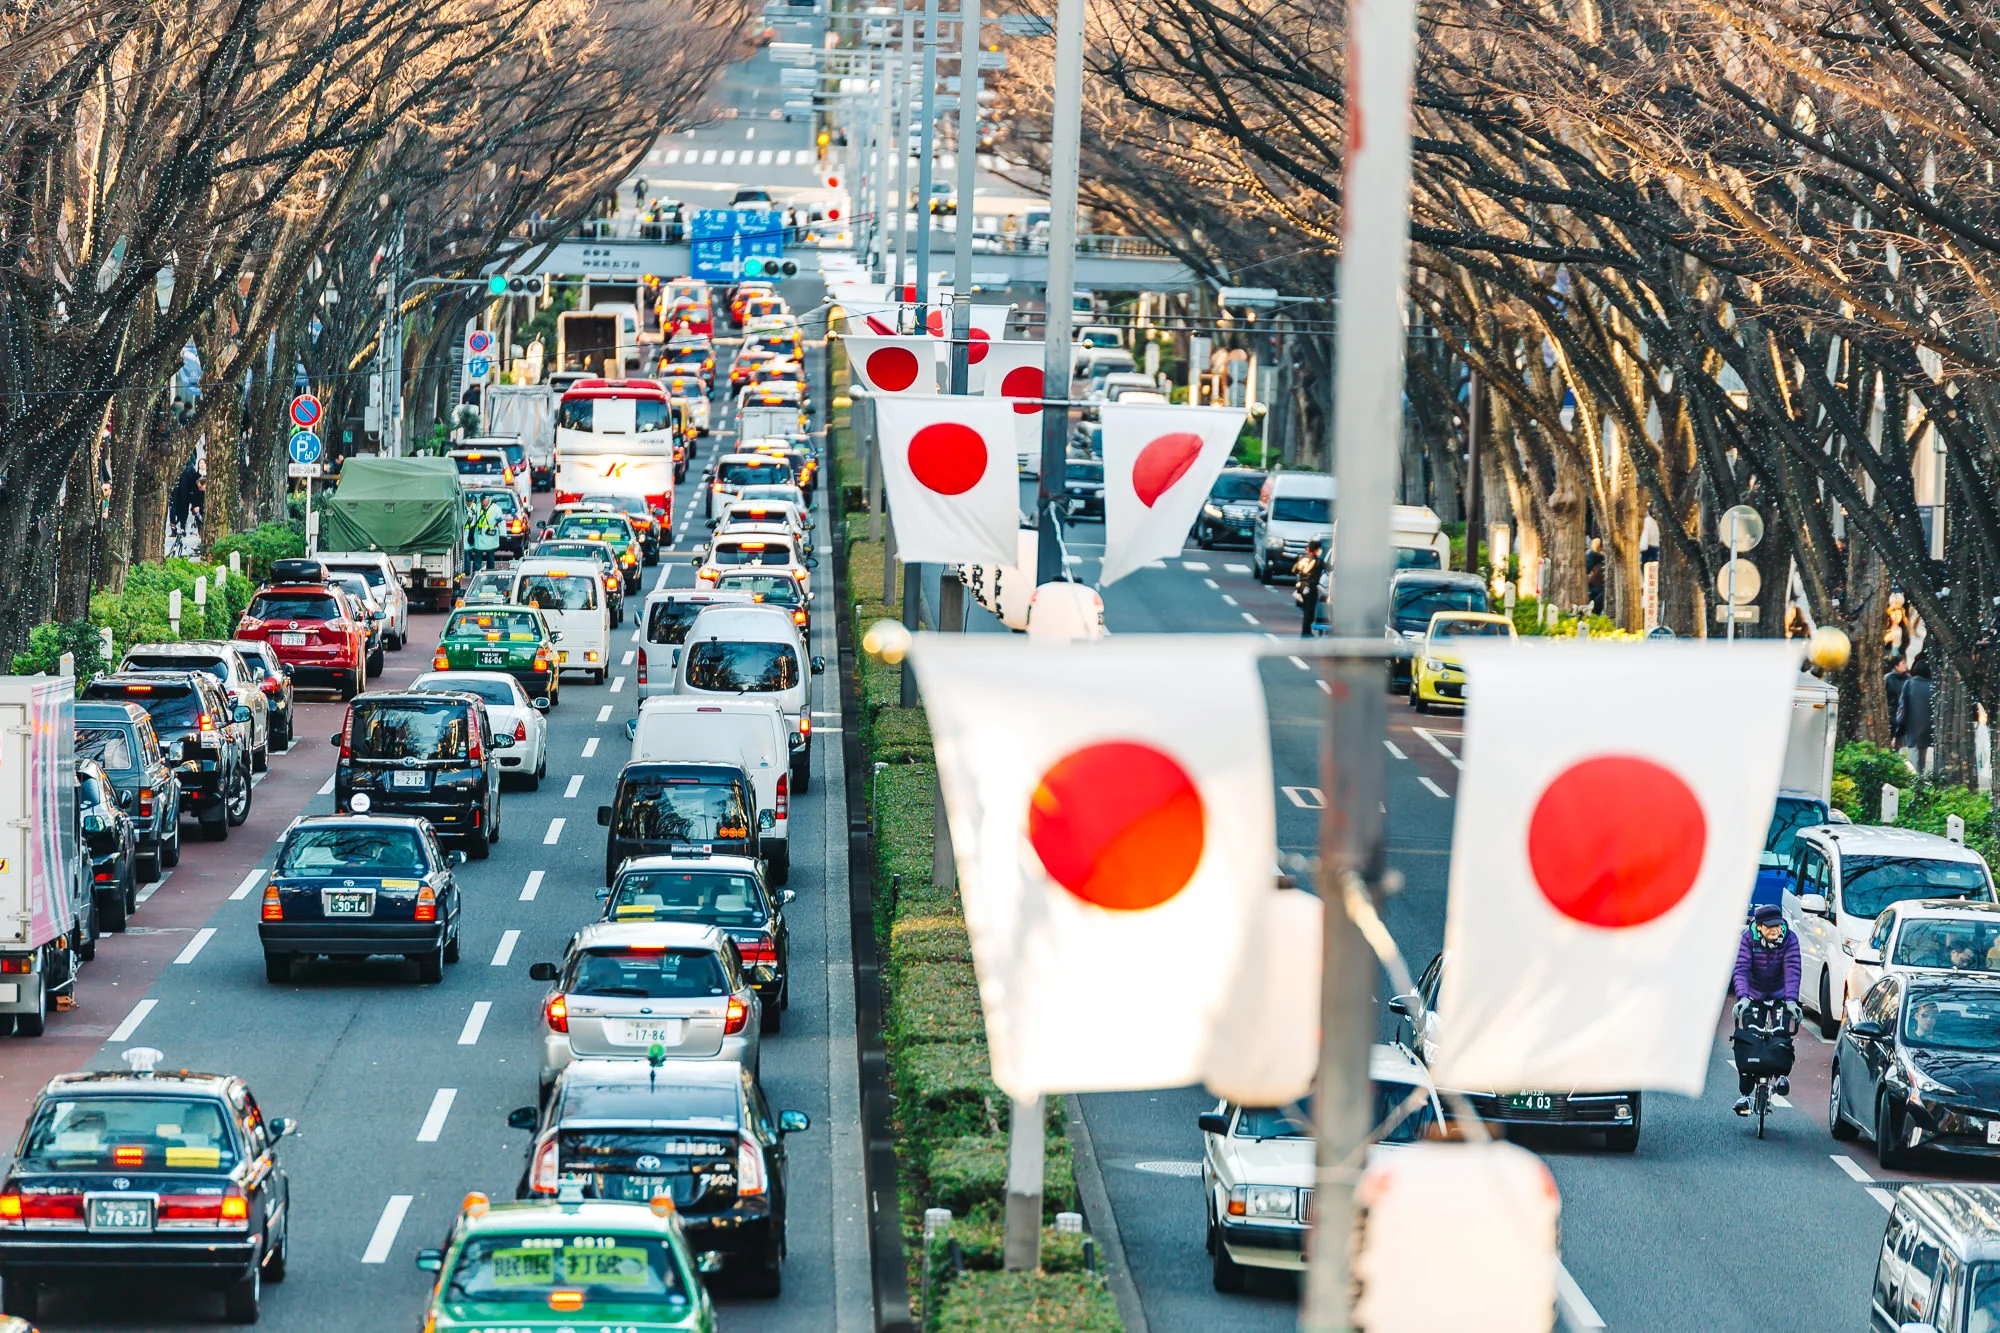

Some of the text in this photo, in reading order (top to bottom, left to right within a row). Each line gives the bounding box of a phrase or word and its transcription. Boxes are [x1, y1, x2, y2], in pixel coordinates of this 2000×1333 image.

[296, 441, 308, 461] P
[304, 451, 314, 460] 60
[635, 1030, 665, 1041] 17-86
[106, 1210, 147, 1226] 78-37
